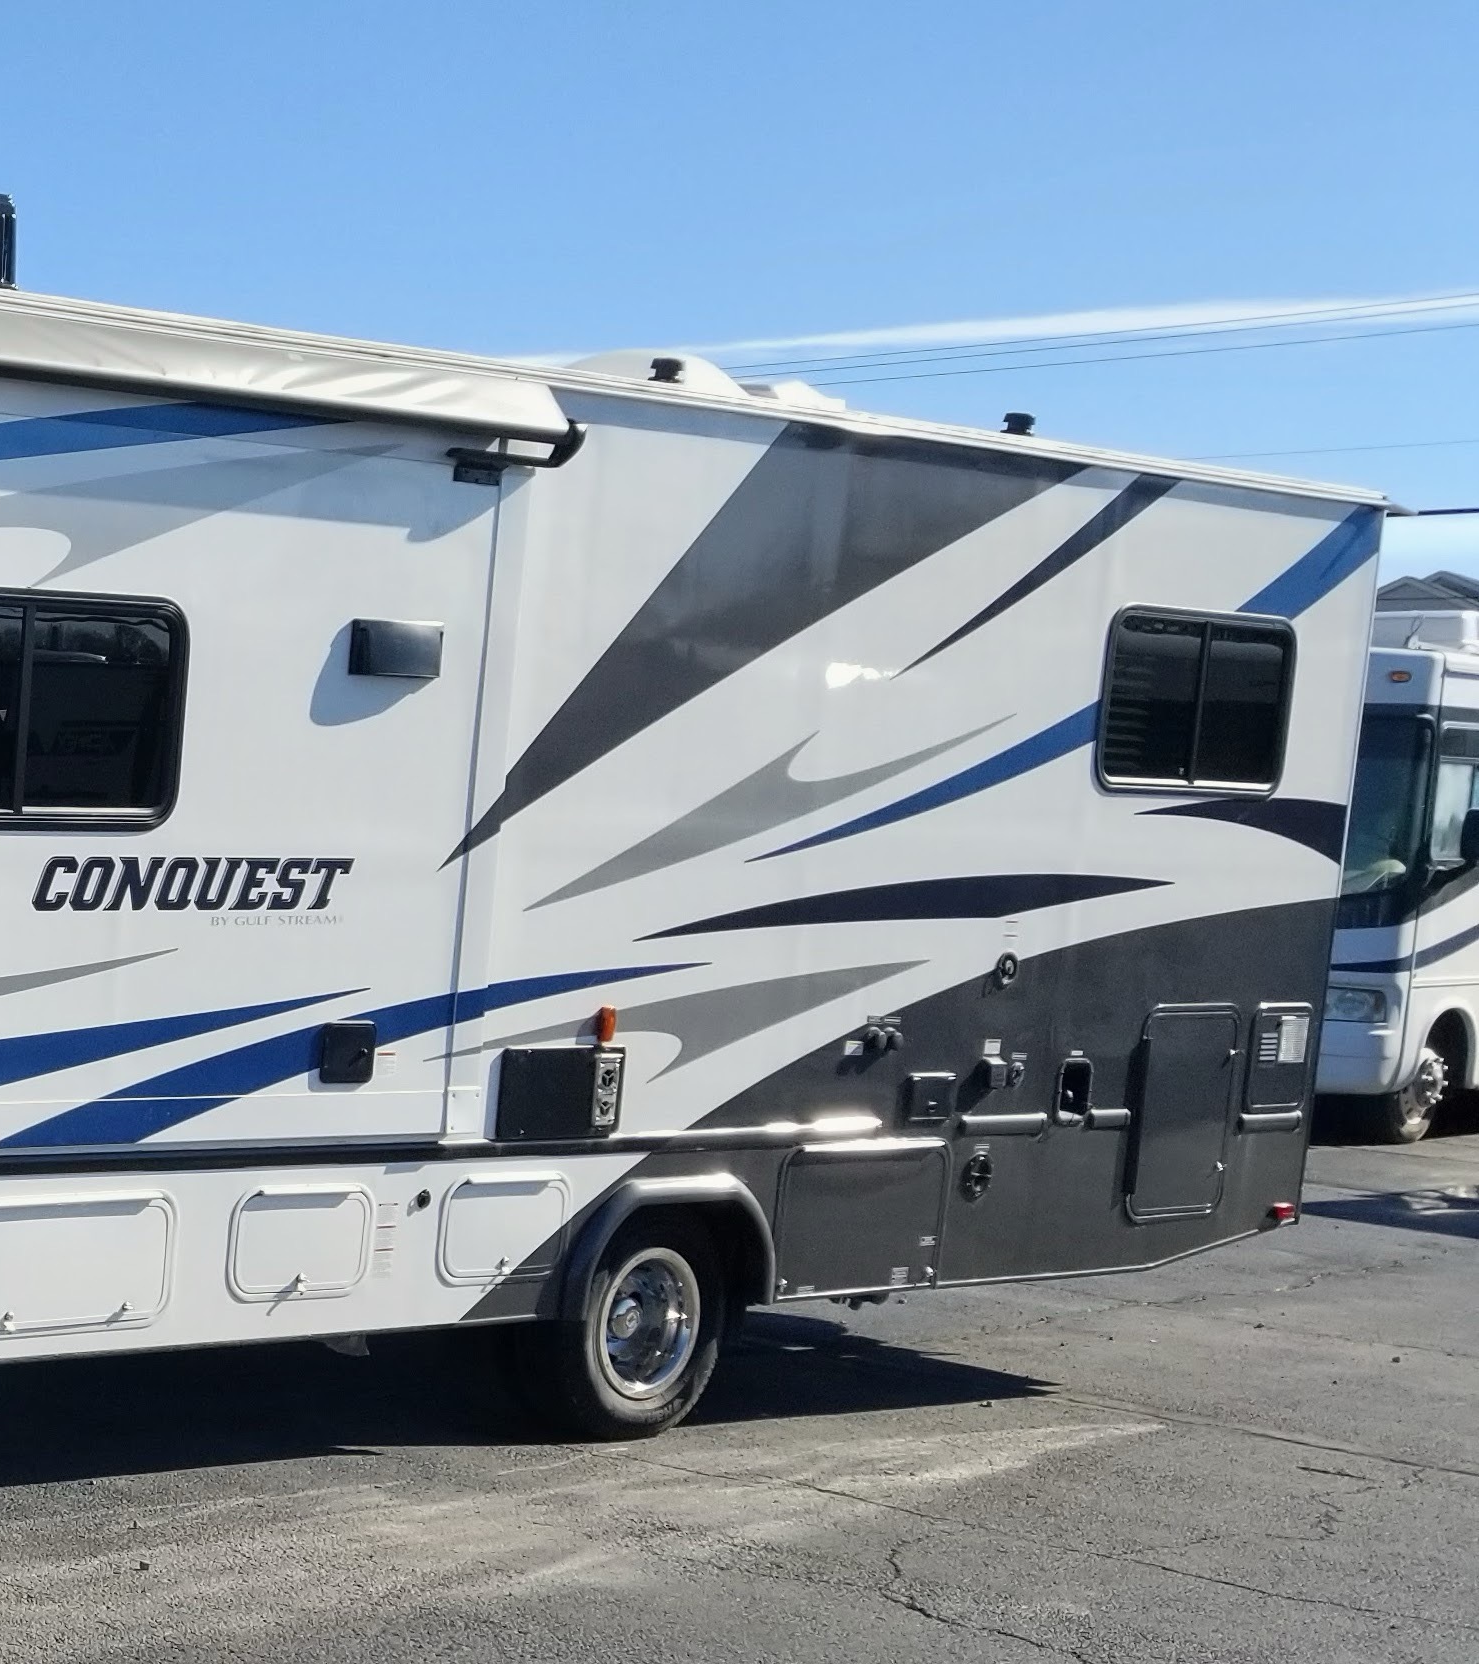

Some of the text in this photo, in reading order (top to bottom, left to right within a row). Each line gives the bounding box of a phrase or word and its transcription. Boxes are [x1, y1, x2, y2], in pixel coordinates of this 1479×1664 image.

[31, 856, 356, 911] CONQUEST
[211, 916, 230, 926] BY
[234, 915, 272, 926] GULF
